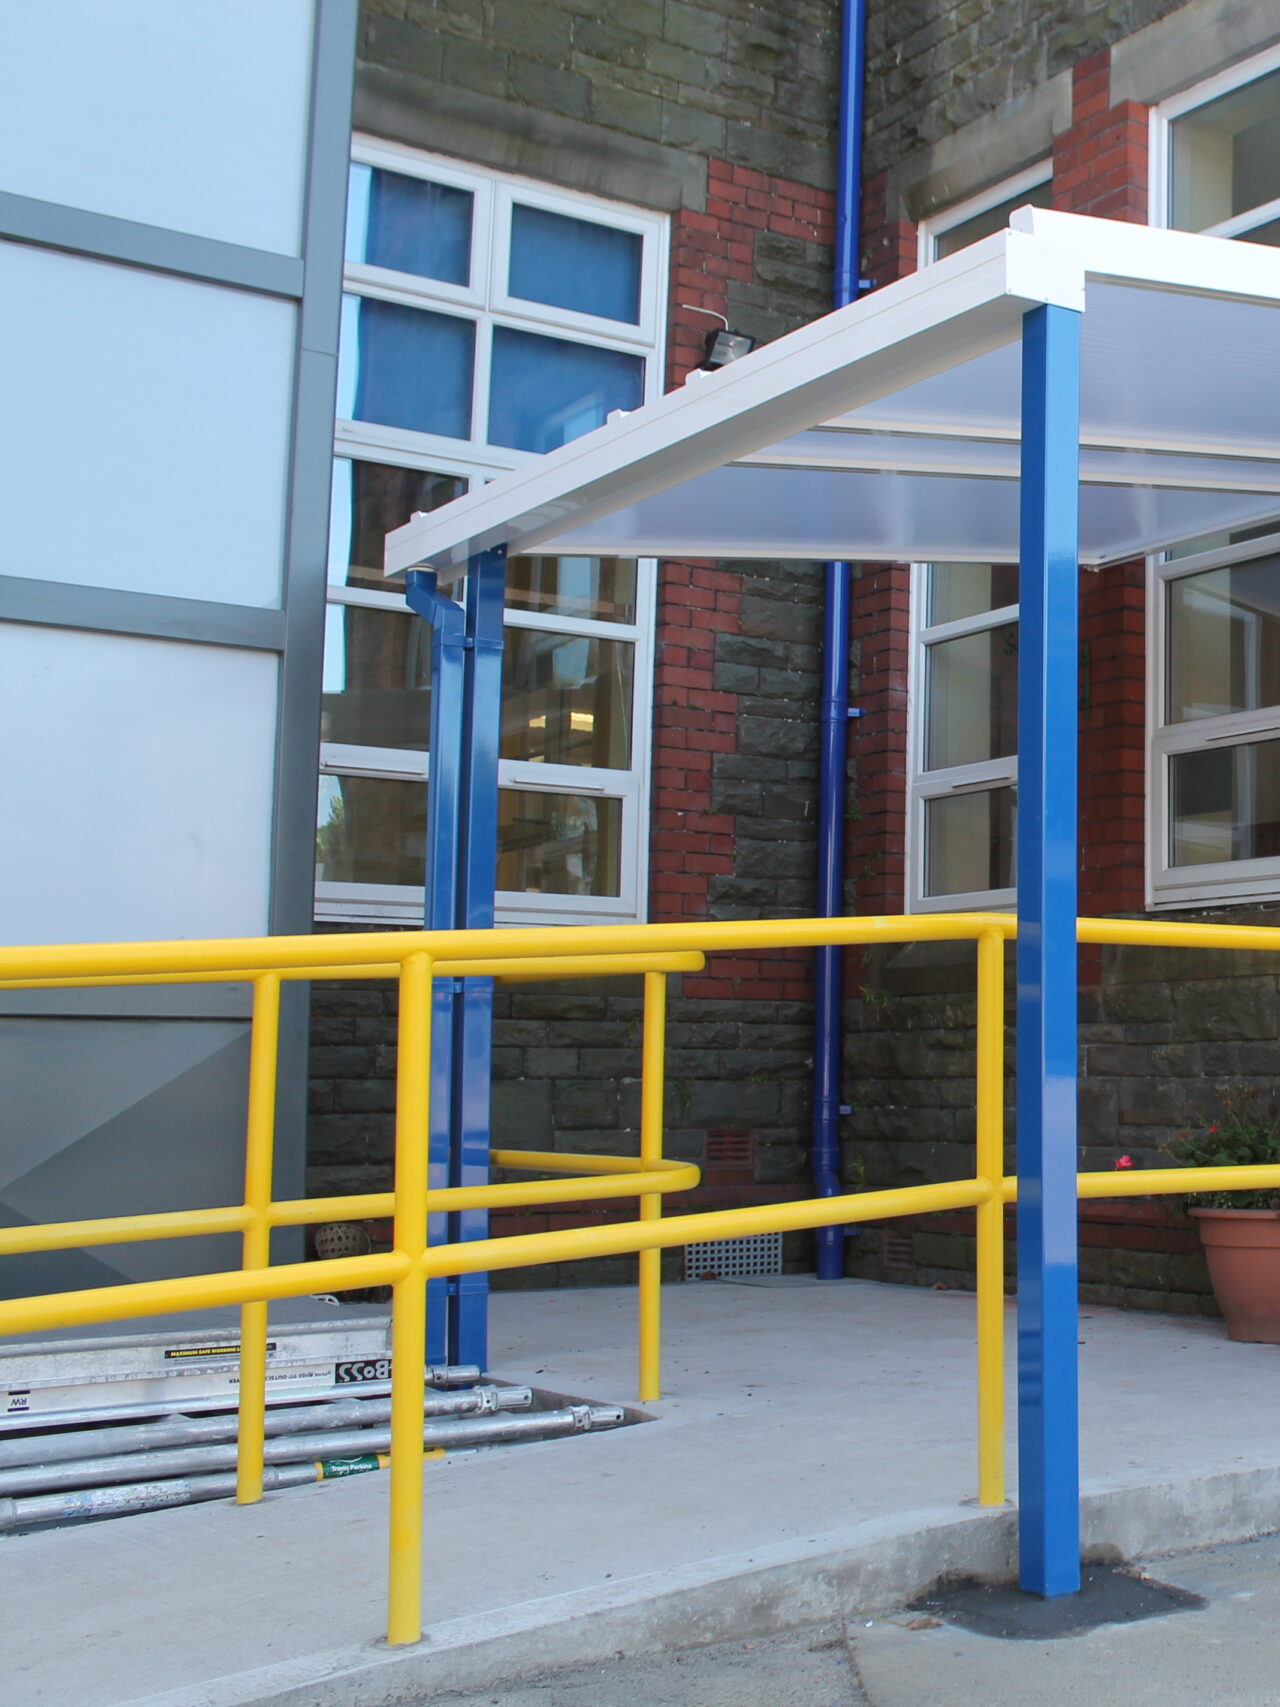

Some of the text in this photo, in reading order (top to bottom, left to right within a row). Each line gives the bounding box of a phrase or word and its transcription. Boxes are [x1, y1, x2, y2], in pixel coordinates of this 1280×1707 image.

[11, 1397, 27, 1406] RW
[331, 1463, 372, 1473] Travis Perkins
